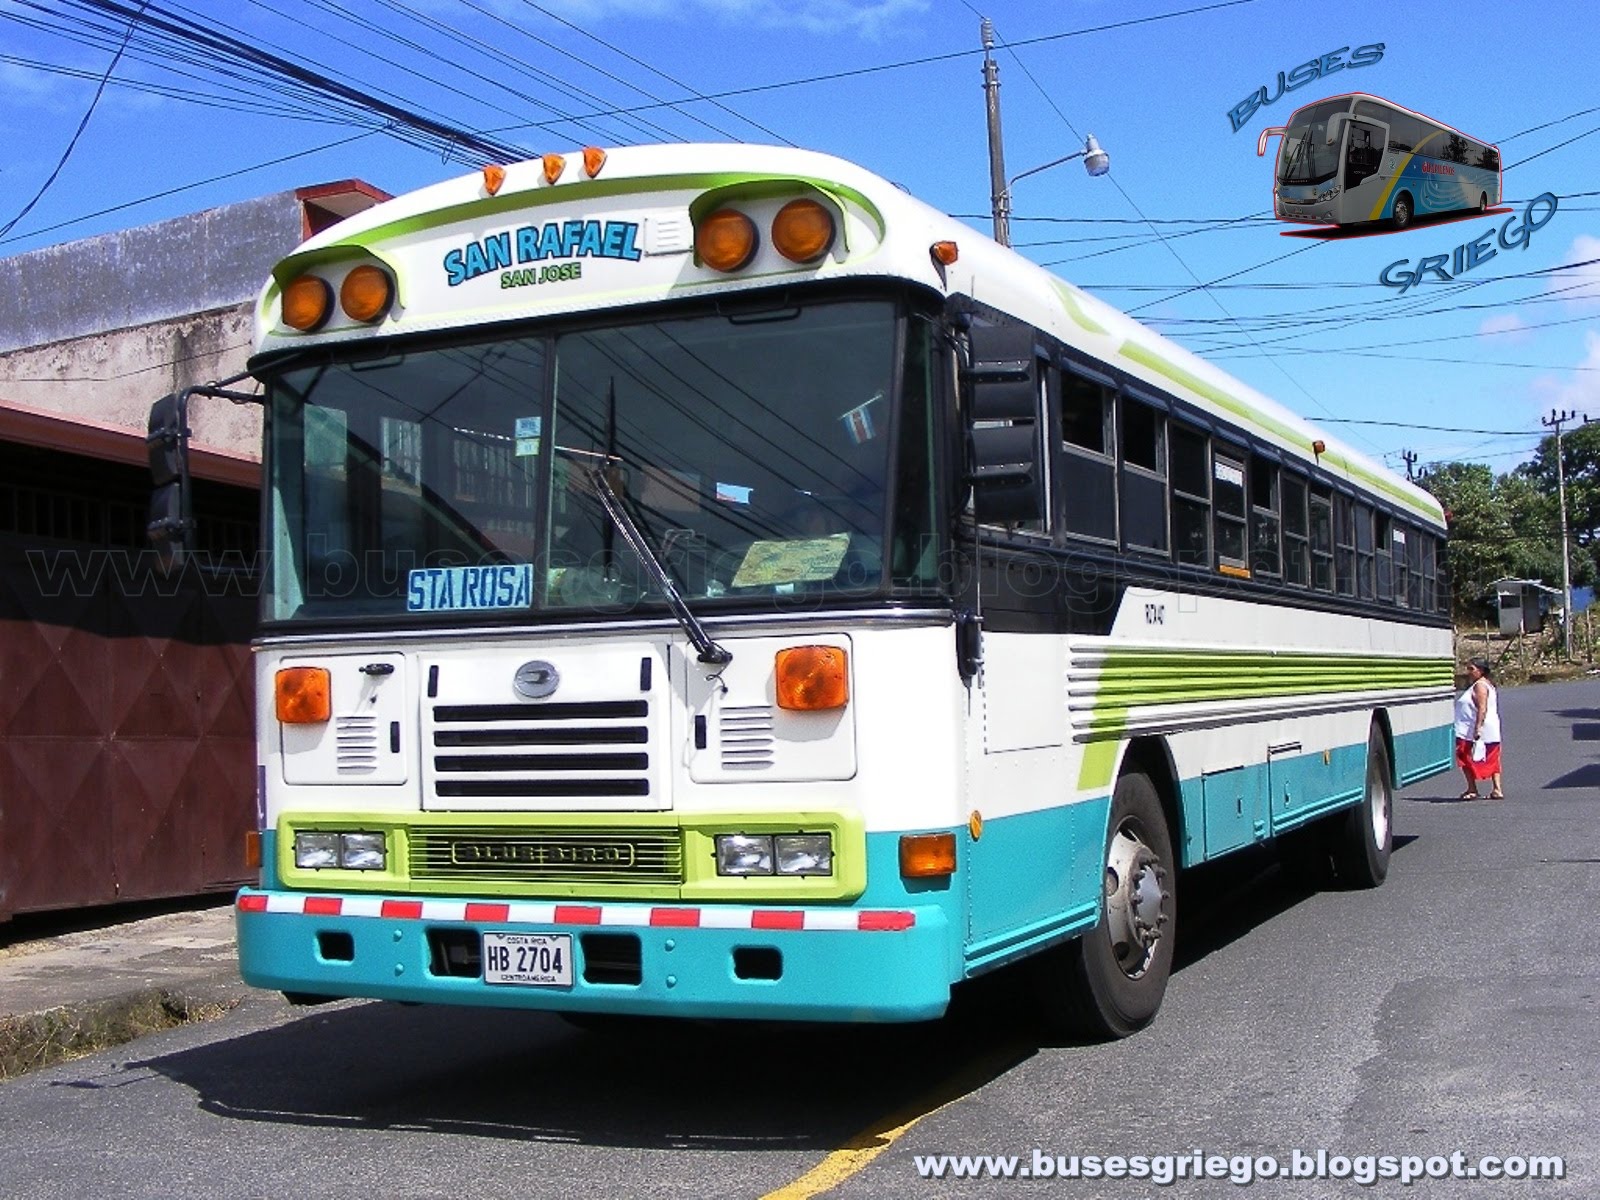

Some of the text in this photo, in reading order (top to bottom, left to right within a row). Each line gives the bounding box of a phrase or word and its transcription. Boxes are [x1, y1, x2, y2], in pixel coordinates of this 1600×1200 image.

[443, 219, 643, 288] SAN RAFAEL
[500, 261, 582, 290] SAN JOSE
[408, 566, 531, 610] STA ROSA
[506, 936, 529, 945] COSTA
[487, 945, 563, 974] HB 2704
